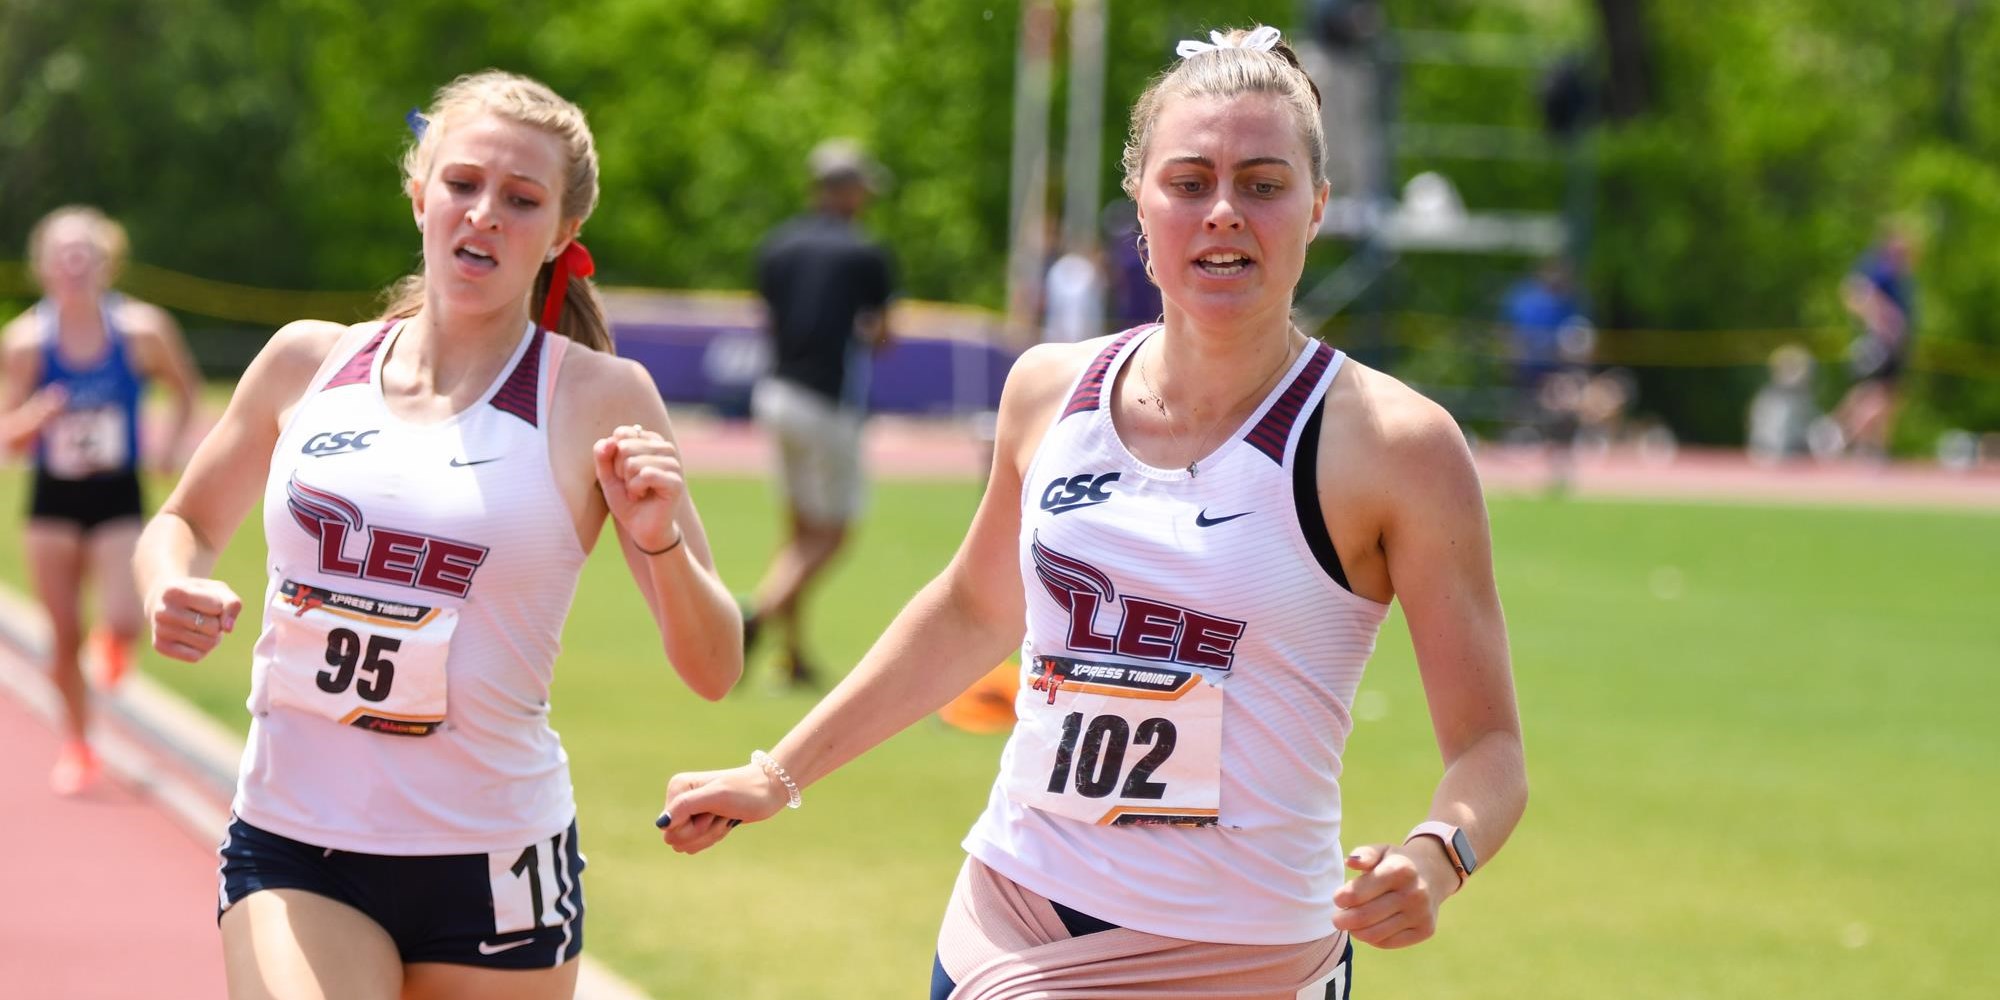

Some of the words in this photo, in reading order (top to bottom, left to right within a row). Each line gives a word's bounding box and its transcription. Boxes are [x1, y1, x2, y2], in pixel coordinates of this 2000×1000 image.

[301, 430, 380, 455] GSC
[1040, 472, 1121, 510] GSC
[318, 516, 490, 599] LEE
[316, 627, 402, 702] 95
[1066, 588, 1247, 671] LEE
[1071, 663, 1125, 680] XPRESS
[1128, 670, 1177, 686] TIMING
[1047, 711, 1177, 800] 102
[510, 844, 545, 927] 1
